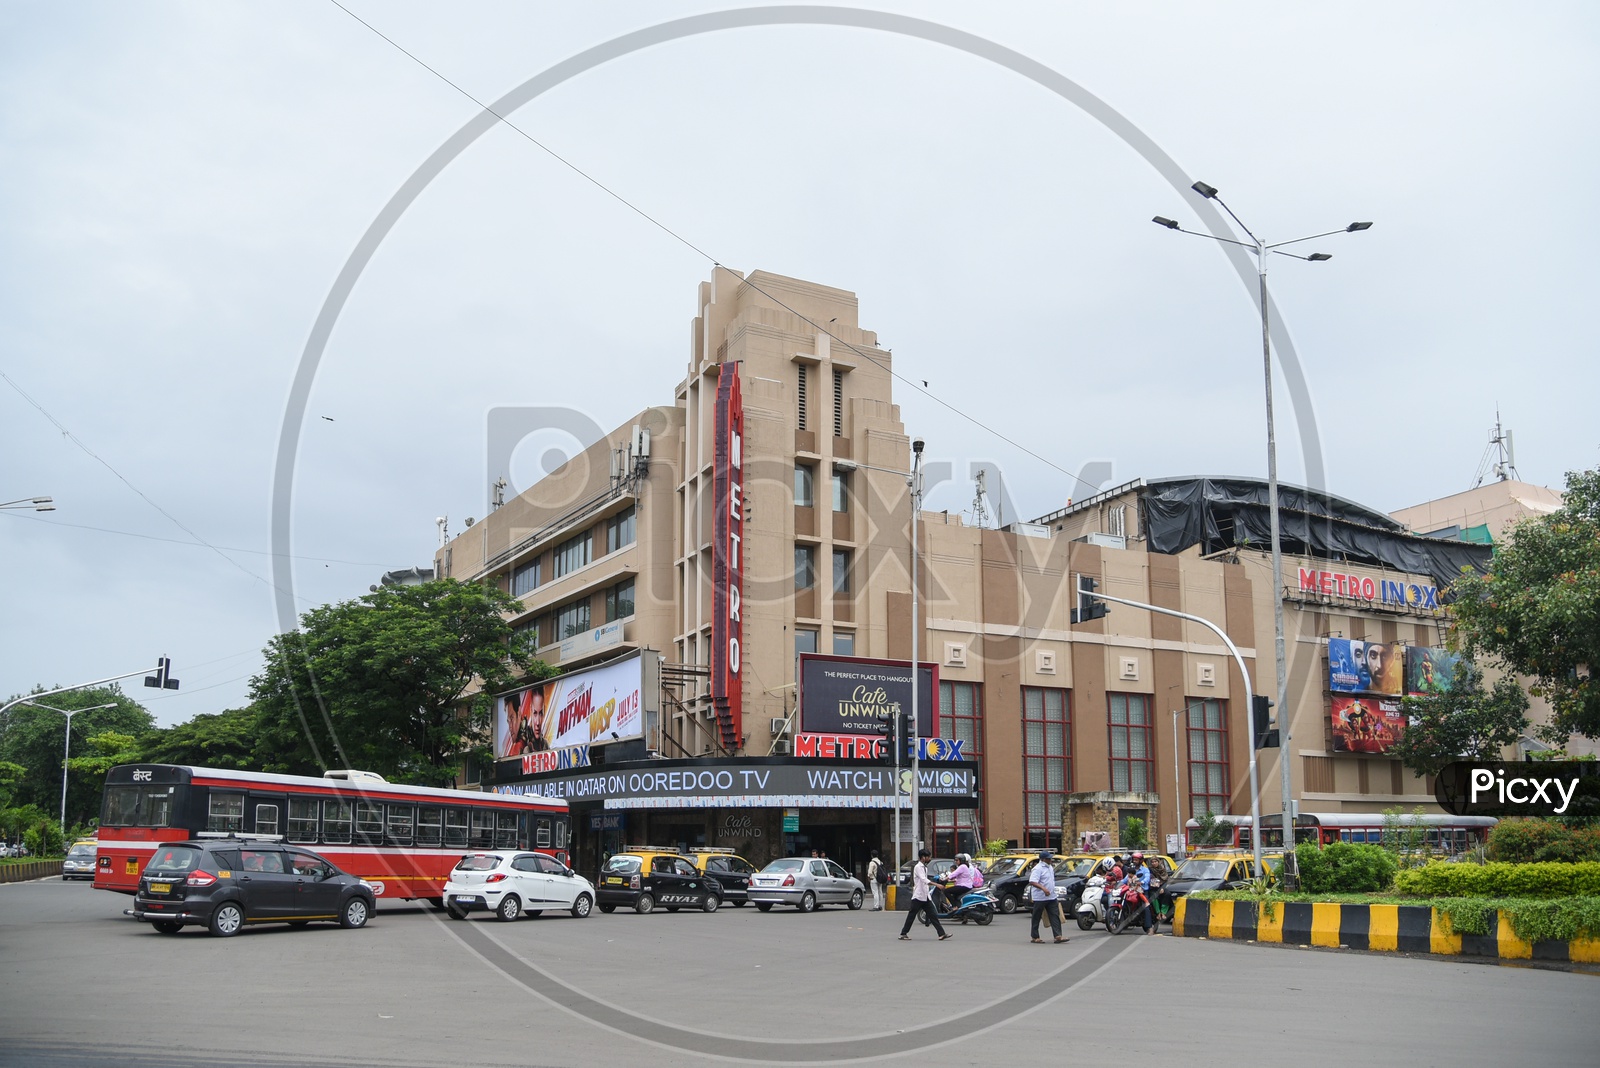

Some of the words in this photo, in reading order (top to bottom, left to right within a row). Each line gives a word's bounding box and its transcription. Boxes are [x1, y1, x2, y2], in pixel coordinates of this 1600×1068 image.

[730, 430, 741, 673] METRO
[1298, 568, 1376, 601] METRO
[1380, 579, 1438, 610] INOX
[617, 695, 630, 722] JULY
[632, 689, 638, 710] 13
[852, 685, 888, 704] Café
[522, 752, 558, 775] METRO
[559, 745, 590, 769] INOX
[899, 738, 966, 761] NOX
[133, 769, 152, 782] बेस्ट
[566, 780, 575, 797] IN
[576, 776, 606, 797] QATAR
[608, 775, 626, 794] ON
[629, 770, 733, 792] OOREDOO
[739, 770, 770, 789] TV
[807, 771, 882, 789] WATCH
[918, 771, 967, 787] WION
[718, 828, 762, 838] UNWIND
[660, 895, 699, 903] RIYAZ
